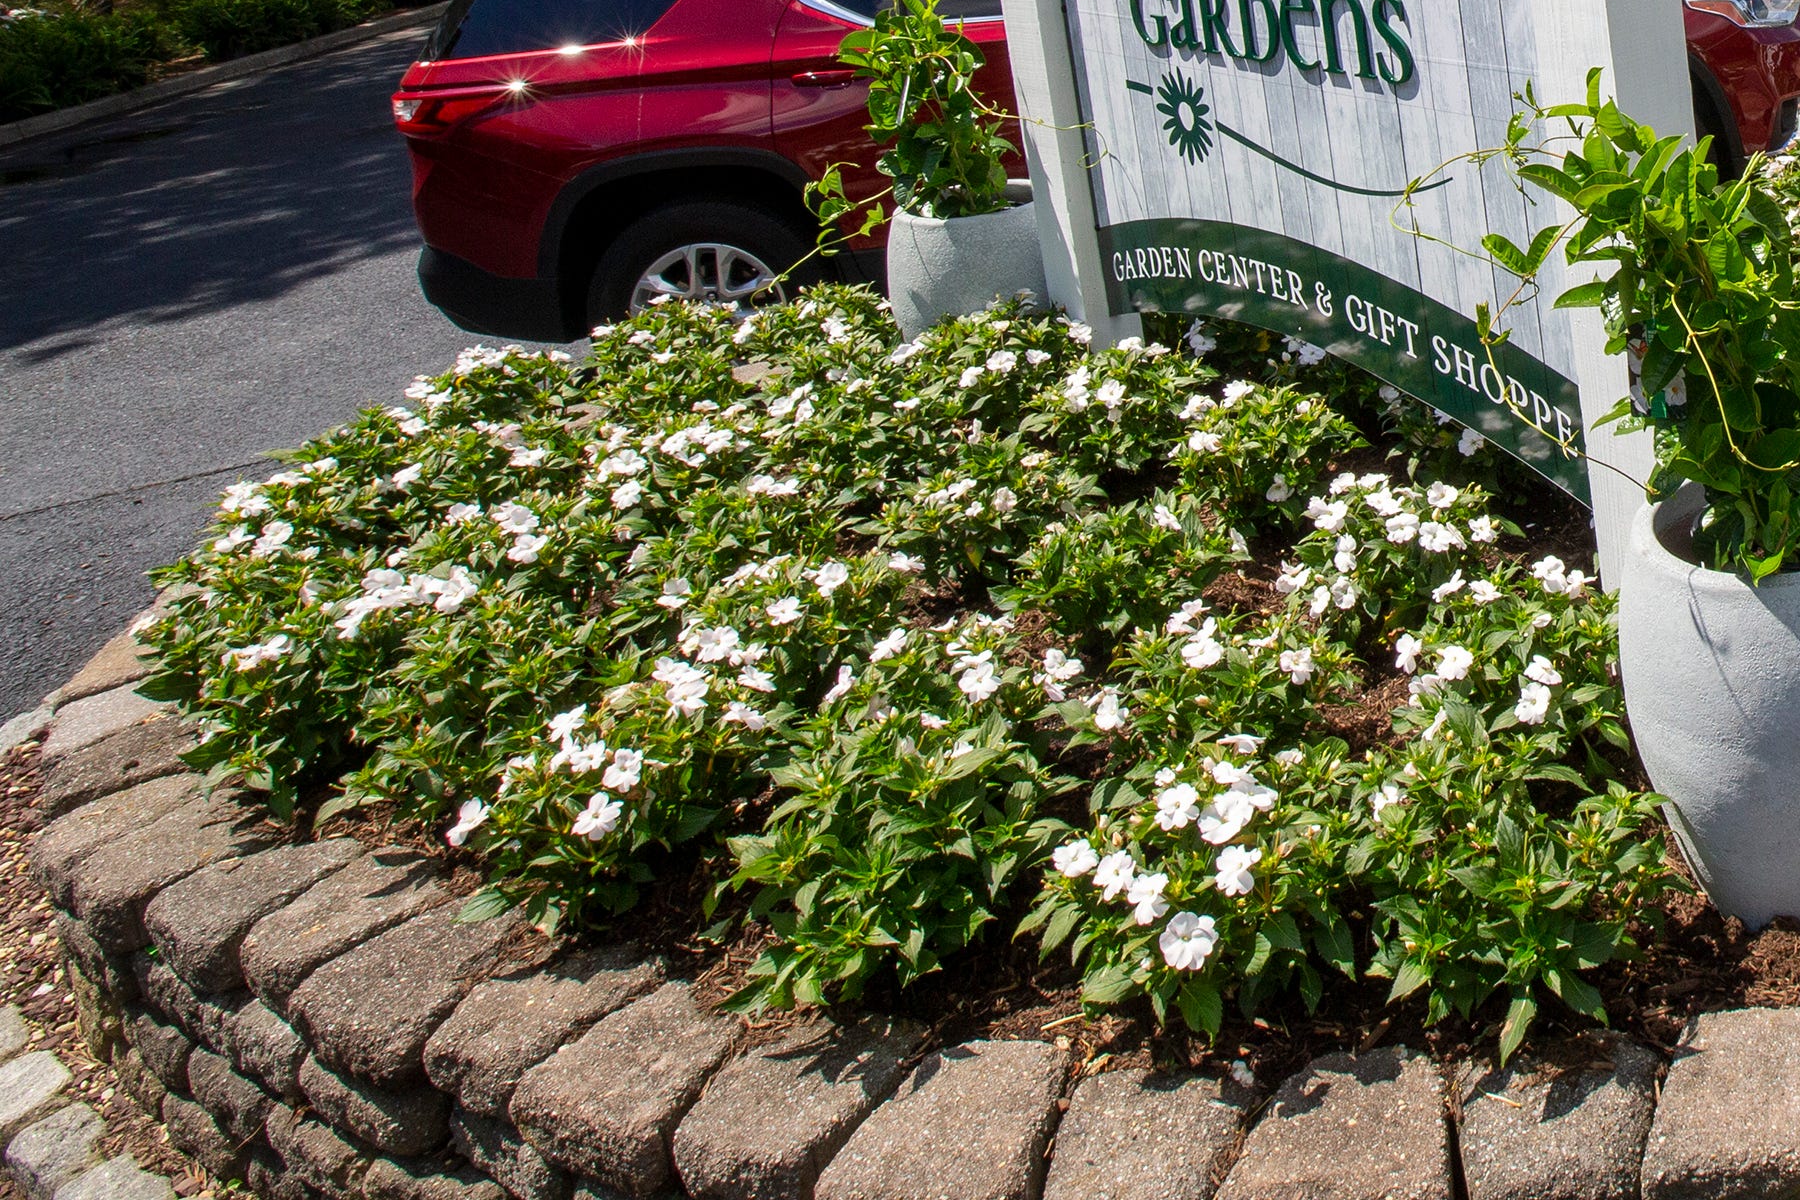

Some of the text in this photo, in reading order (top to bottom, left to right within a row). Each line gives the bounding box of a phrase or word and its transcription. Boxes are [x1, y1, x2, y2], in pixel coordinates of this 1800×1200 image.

[1112, 246, 1579, 458] GARDEN CENTER & GIFT SHOPPE
